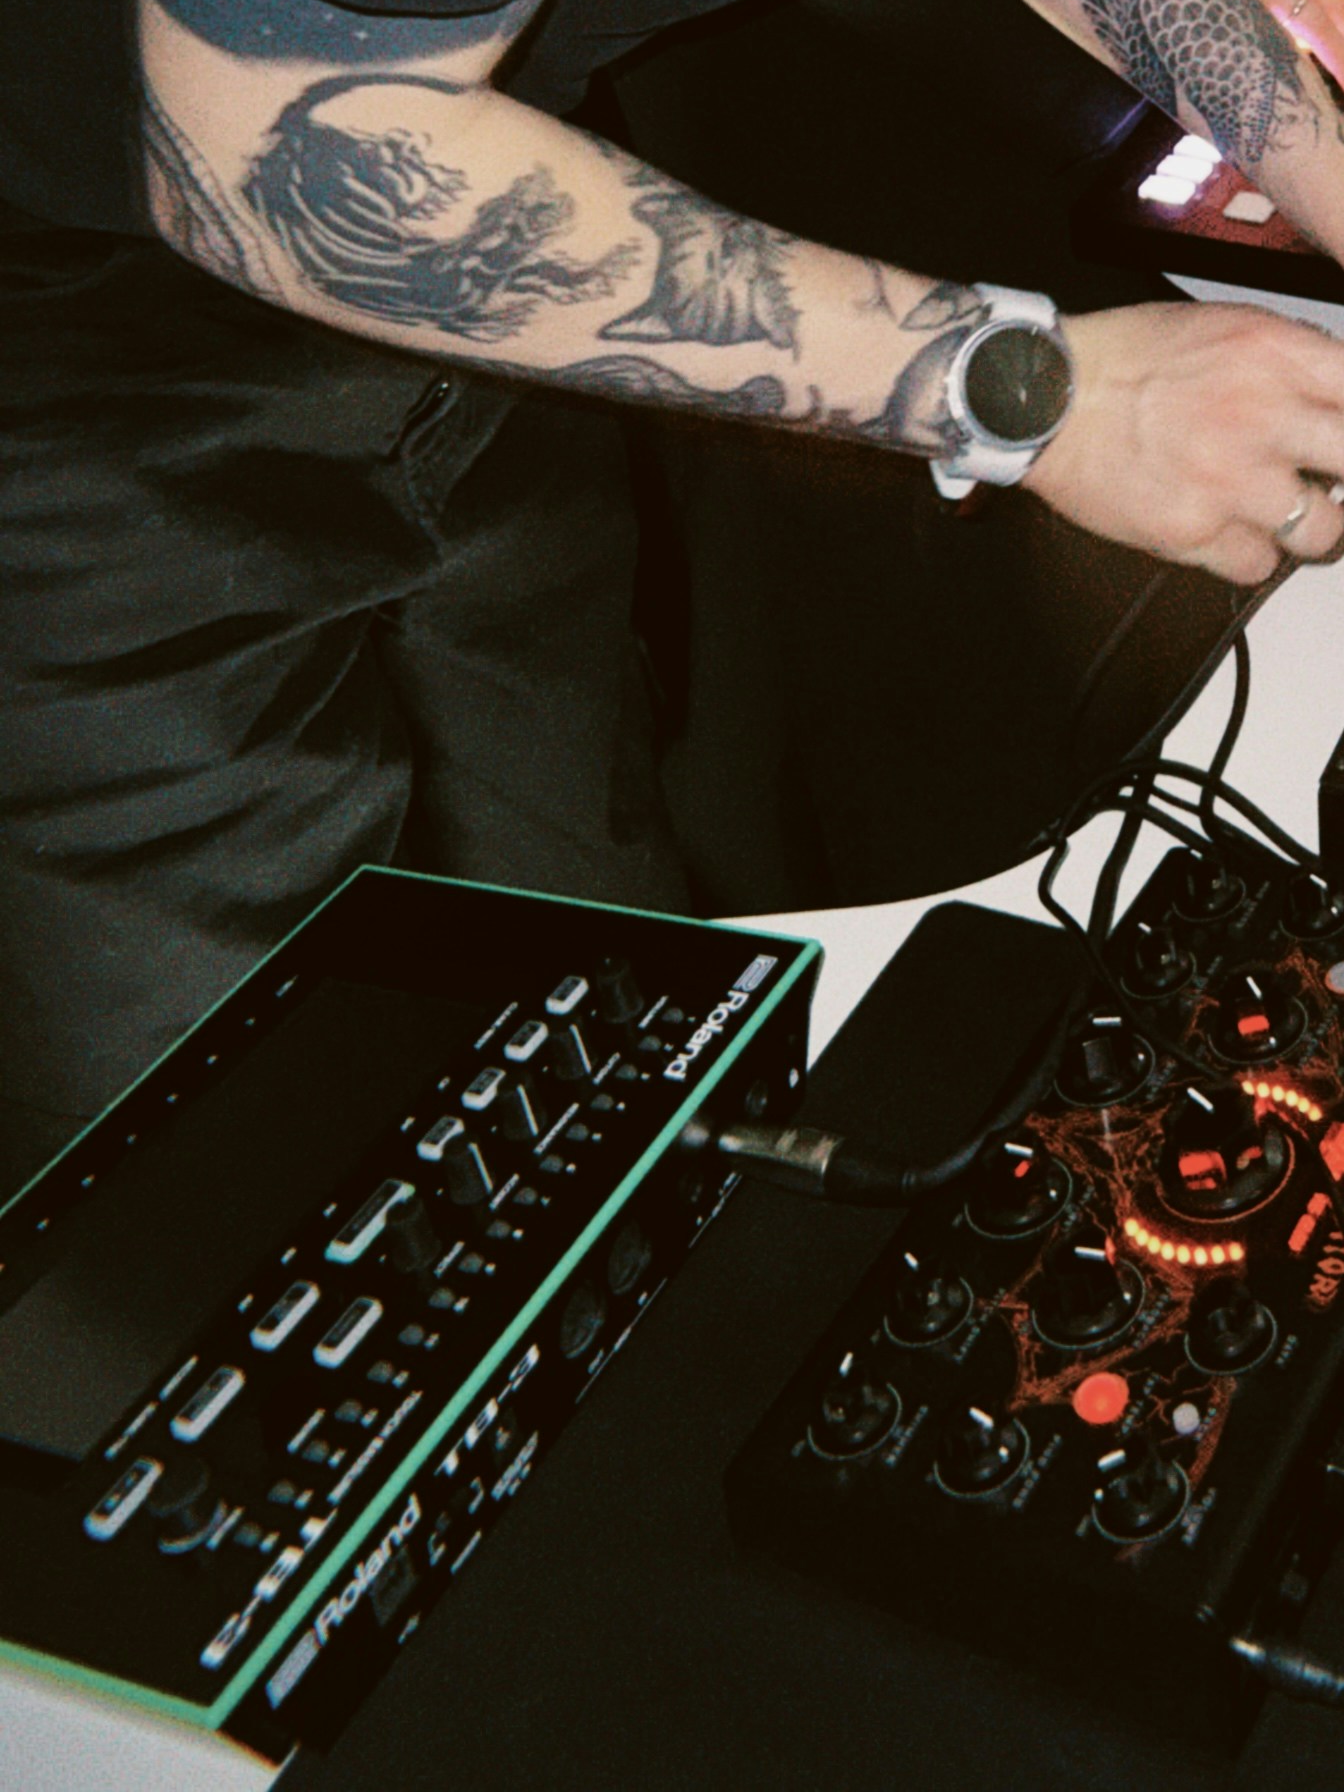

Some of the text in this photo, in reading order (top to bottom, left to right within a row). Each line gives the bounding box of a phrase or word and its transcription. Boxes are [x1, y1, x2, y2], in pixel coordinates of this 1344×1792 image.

[663, 983, 749, 1081] Roland
[326, 1389, 423, 1505] TOUCH BASSLINE
[437, 1343, 542, 1476] TB-3
[200, 1508, 338, 1668] TB-3
[308, 1493, 422, 1644] Roland
